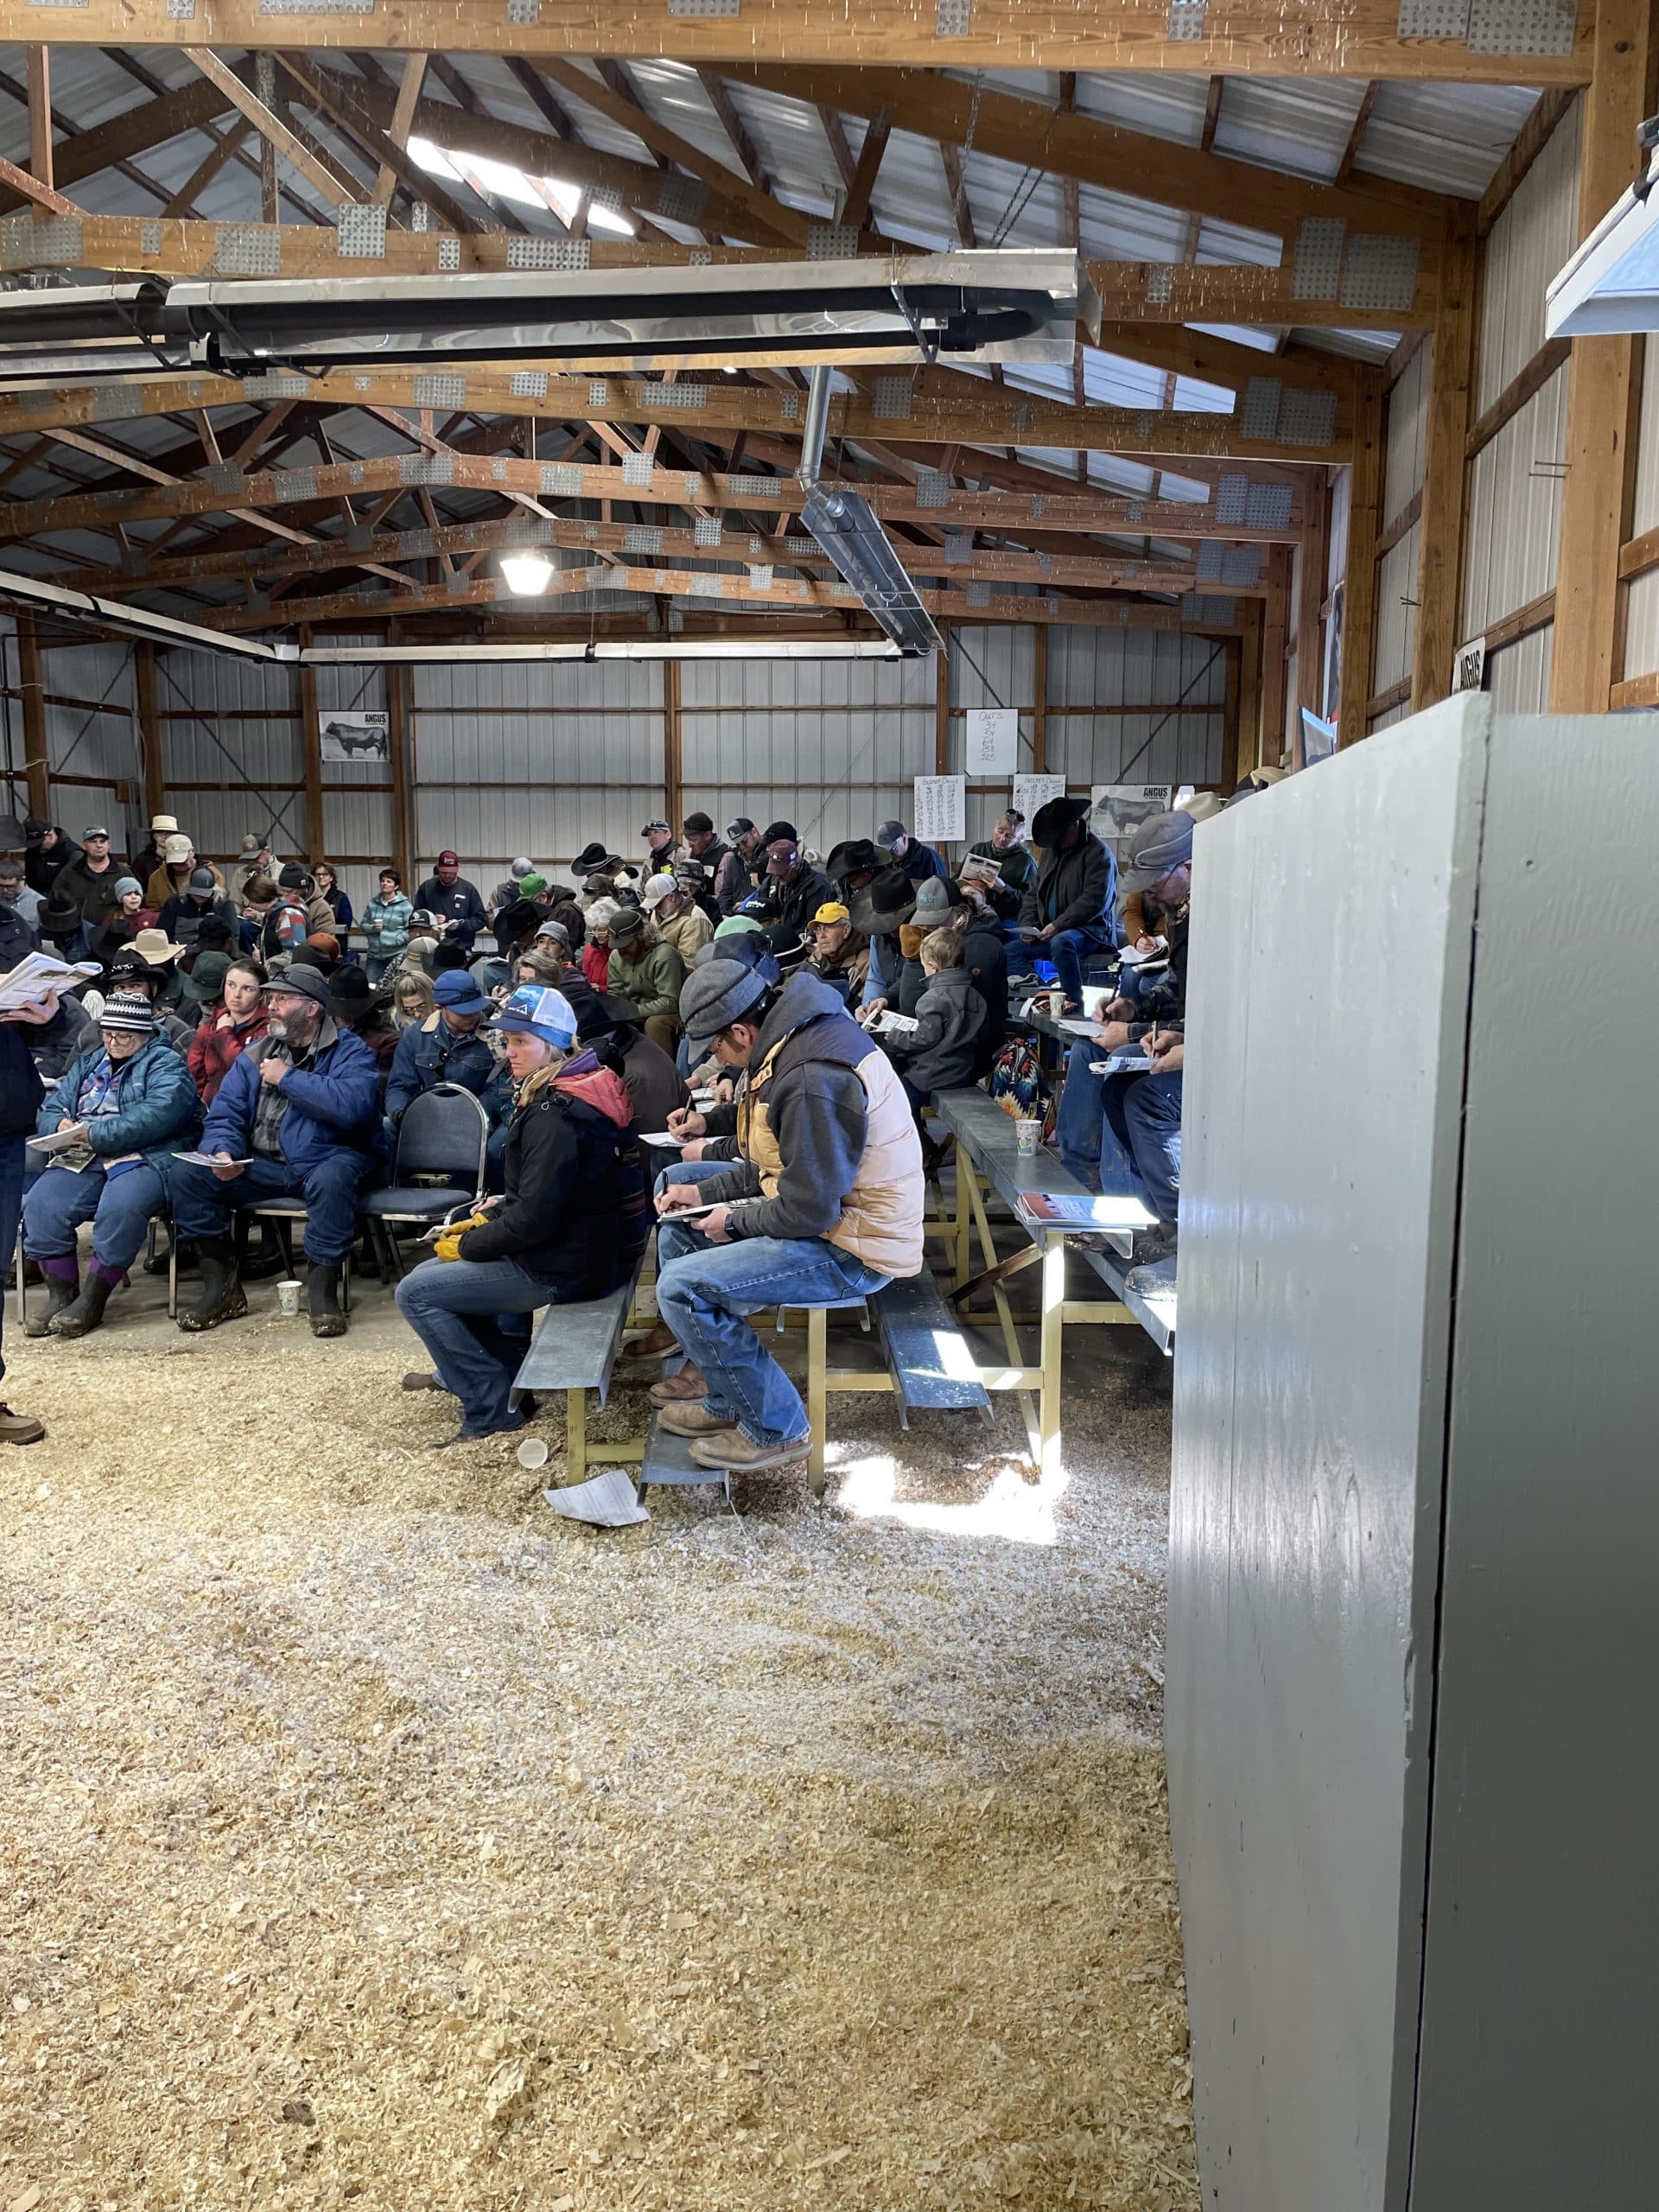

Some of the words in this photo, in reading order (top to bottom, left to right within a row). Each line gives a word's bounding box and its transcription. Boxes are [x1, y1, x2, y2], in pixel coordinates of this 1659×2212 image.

[1460, 650, 1480, 690] ANGUS
[365, 714, 386, 723] ANGUS
[1143, 787, 1168, 797] ANGUS
